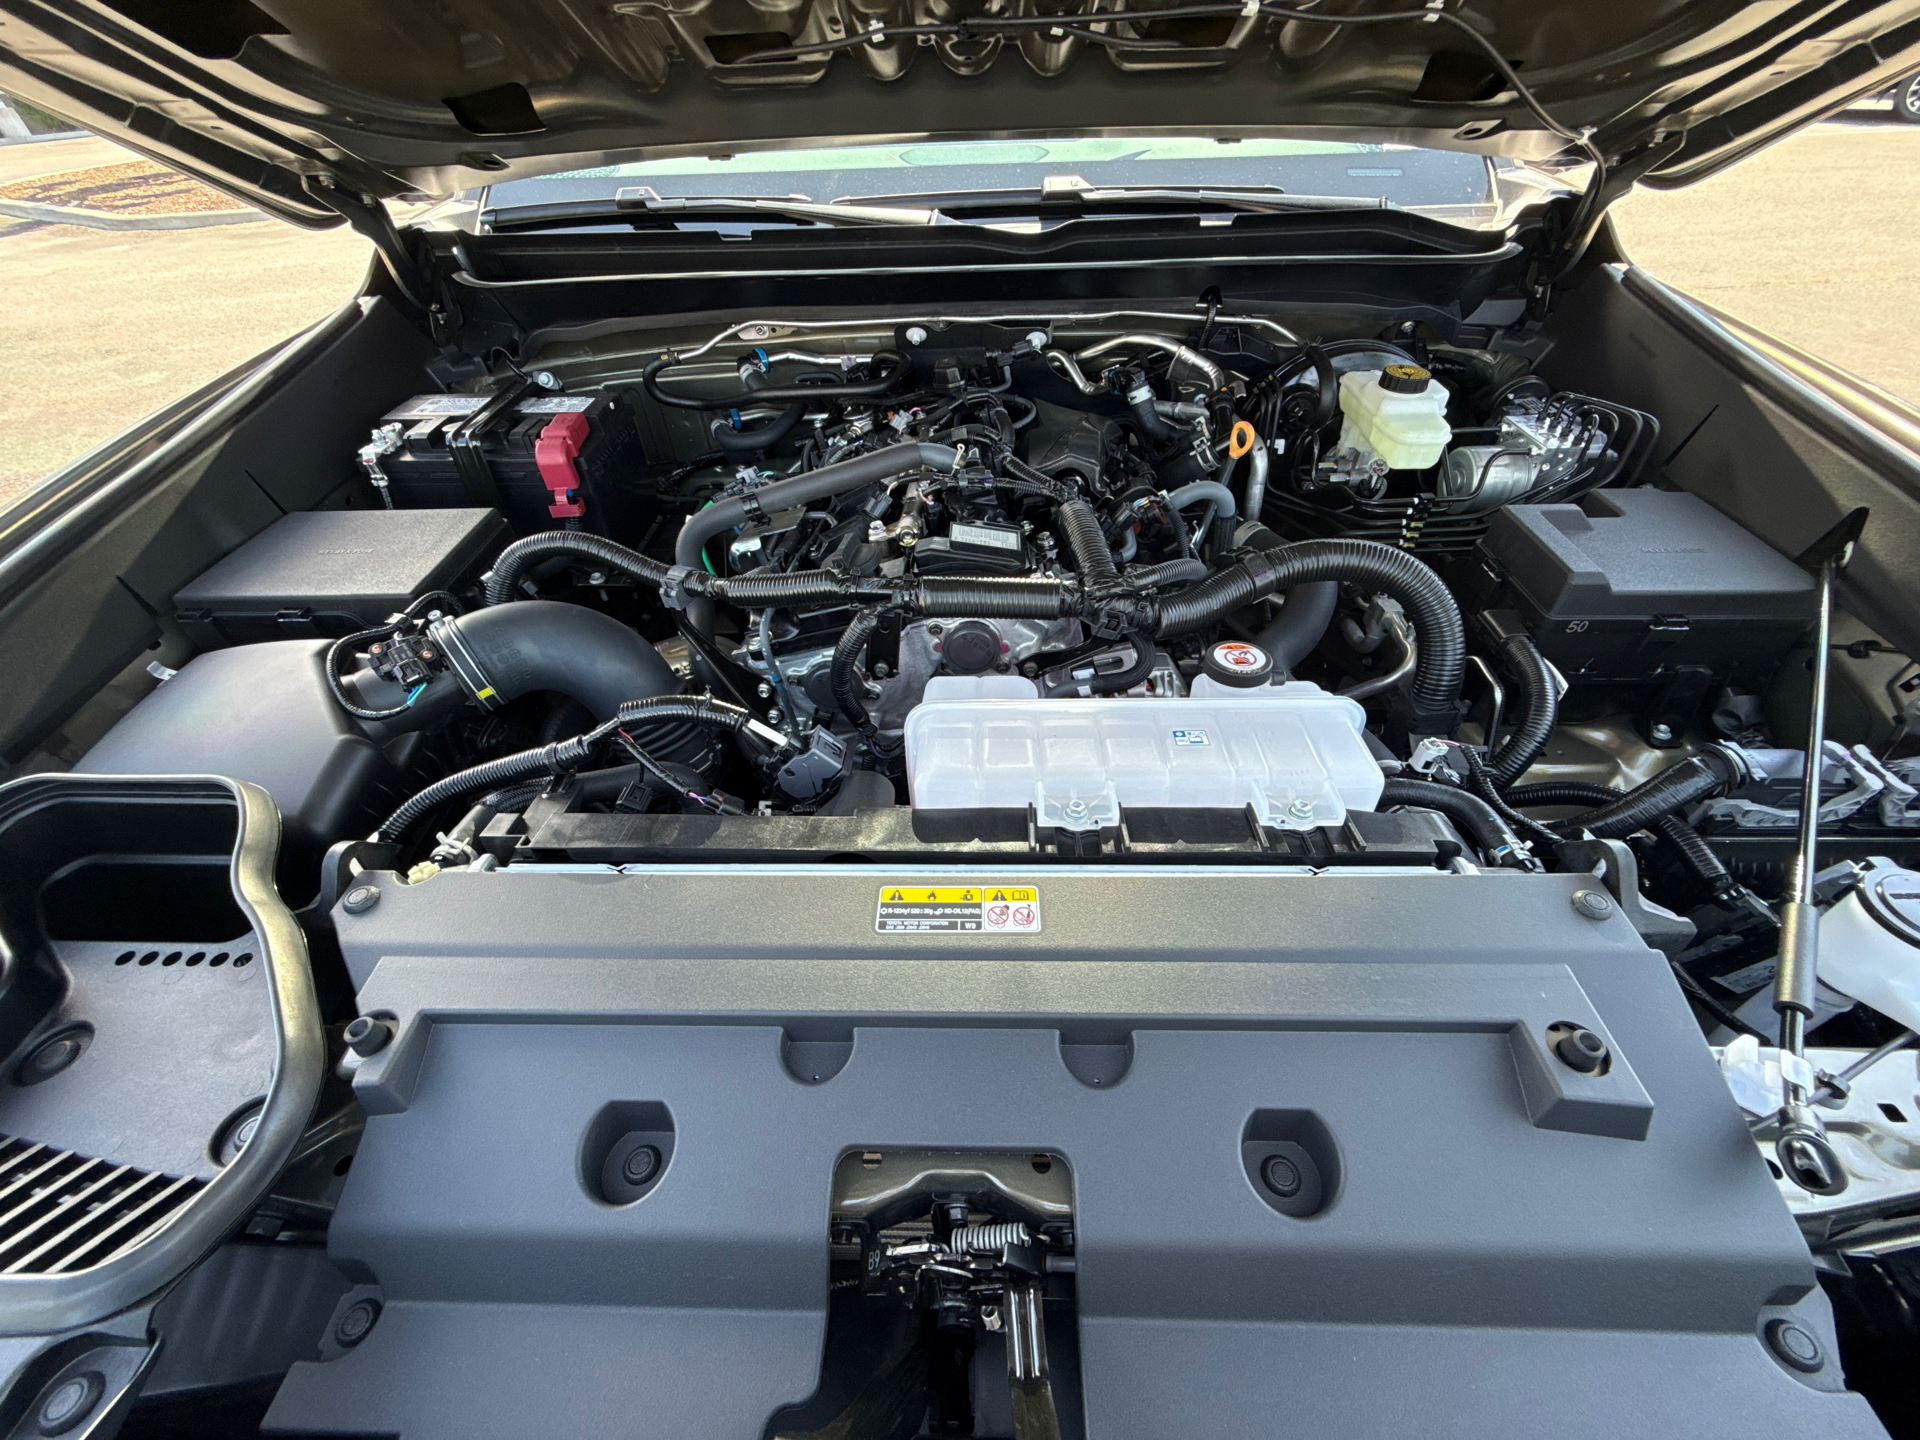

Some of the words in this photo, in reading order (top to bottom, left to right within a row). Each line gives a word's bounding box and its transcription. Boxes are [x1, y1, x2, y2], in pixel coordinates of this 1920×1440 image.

[1565, 620, 1589, 633] 50
[964, 922, 977, 930] W9
[868, 1249, 880, 1271] B9
